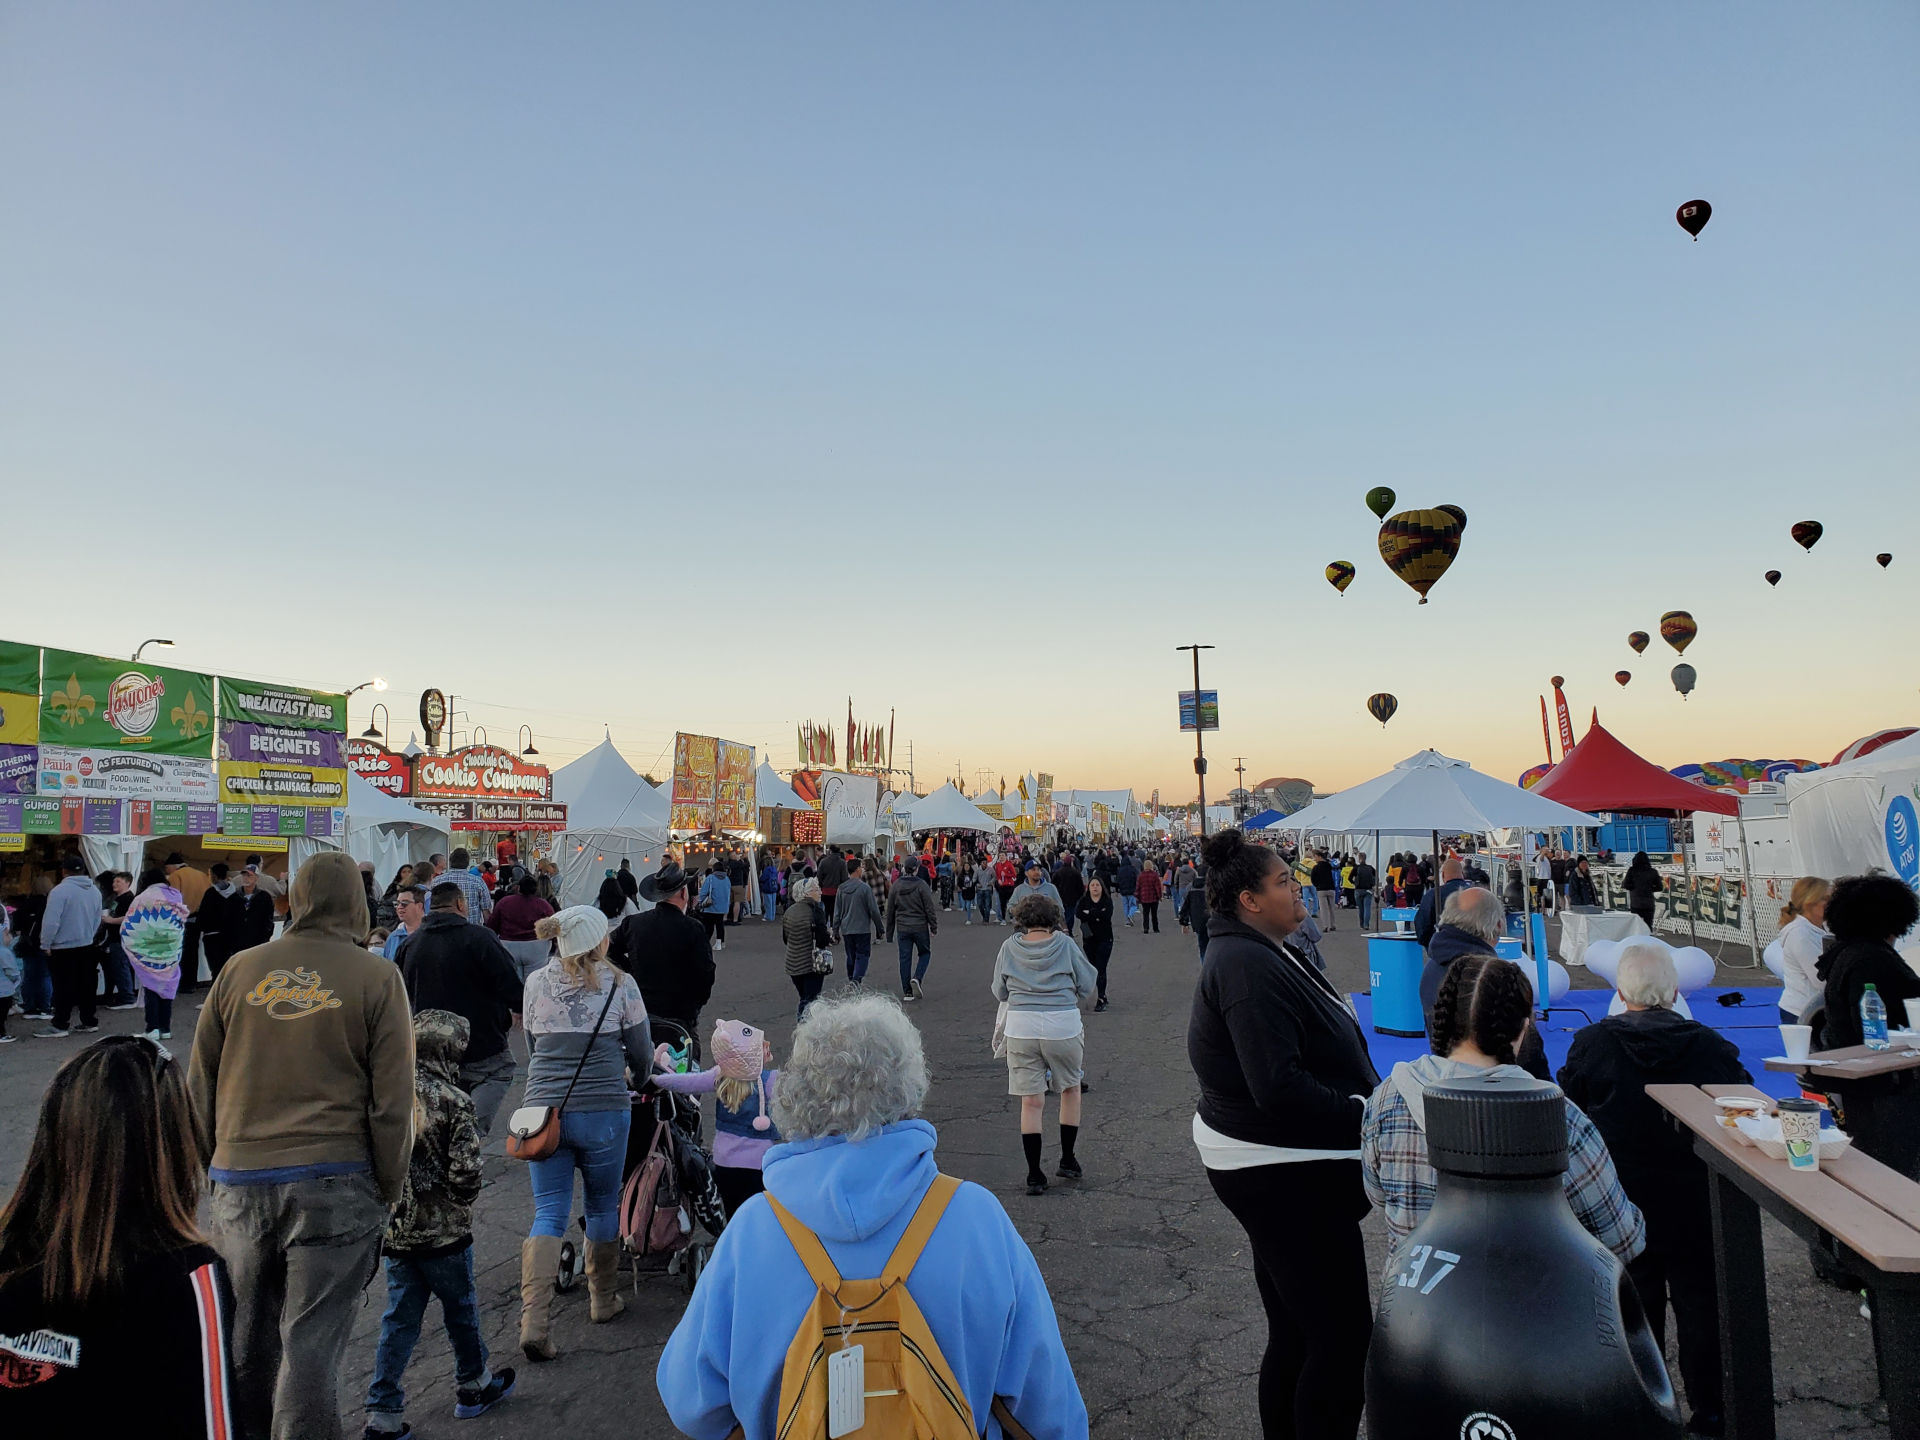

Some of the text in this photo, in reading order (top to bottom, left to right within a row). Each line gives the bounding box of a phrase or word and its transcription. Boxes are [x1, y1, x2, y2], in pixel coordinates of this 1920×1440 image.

[264, 690, 284, 698] FAMOUS
[103, 675, 165, 730] Lasyone's
[238, 694, 332, 720] BREAKFAST PIES
[280, 728, 306, 737] ORLEANS
[250, 734, 320, 756] BEIGNETS
[43, 758, 72, 770] Paula
[98, 758, 161, 774] AS FEATURED IN
[348, 757, 391, 771] okie
[462, 748, 514, 774] Chocolate Chip
[7, 764, 35, 778] COCOA
[260, 770, 292, 779] LOUISIANA
[422, 762, 478, 787] Cookie
[482, 768, 547, 796] Company
[227, 778, 341, 794] CHICKEN & SAUSAGE GUMBO
[24, 801, 60, 811] GUMBO
[477, 805, 519, 819] Fresh Baked
[526, 806, 564, 819] Served Warm
[840, 802, 867, 819] PANDORA
[1900, 844, 1915, 871] AT&T
[1370, 970, 1382, 988] &T
[246, 966, 342, 1020] Gotcha
[1398, 1245, 1460, 1295] 37
[1592, 1269, 1618, 1348] BOTTLES
